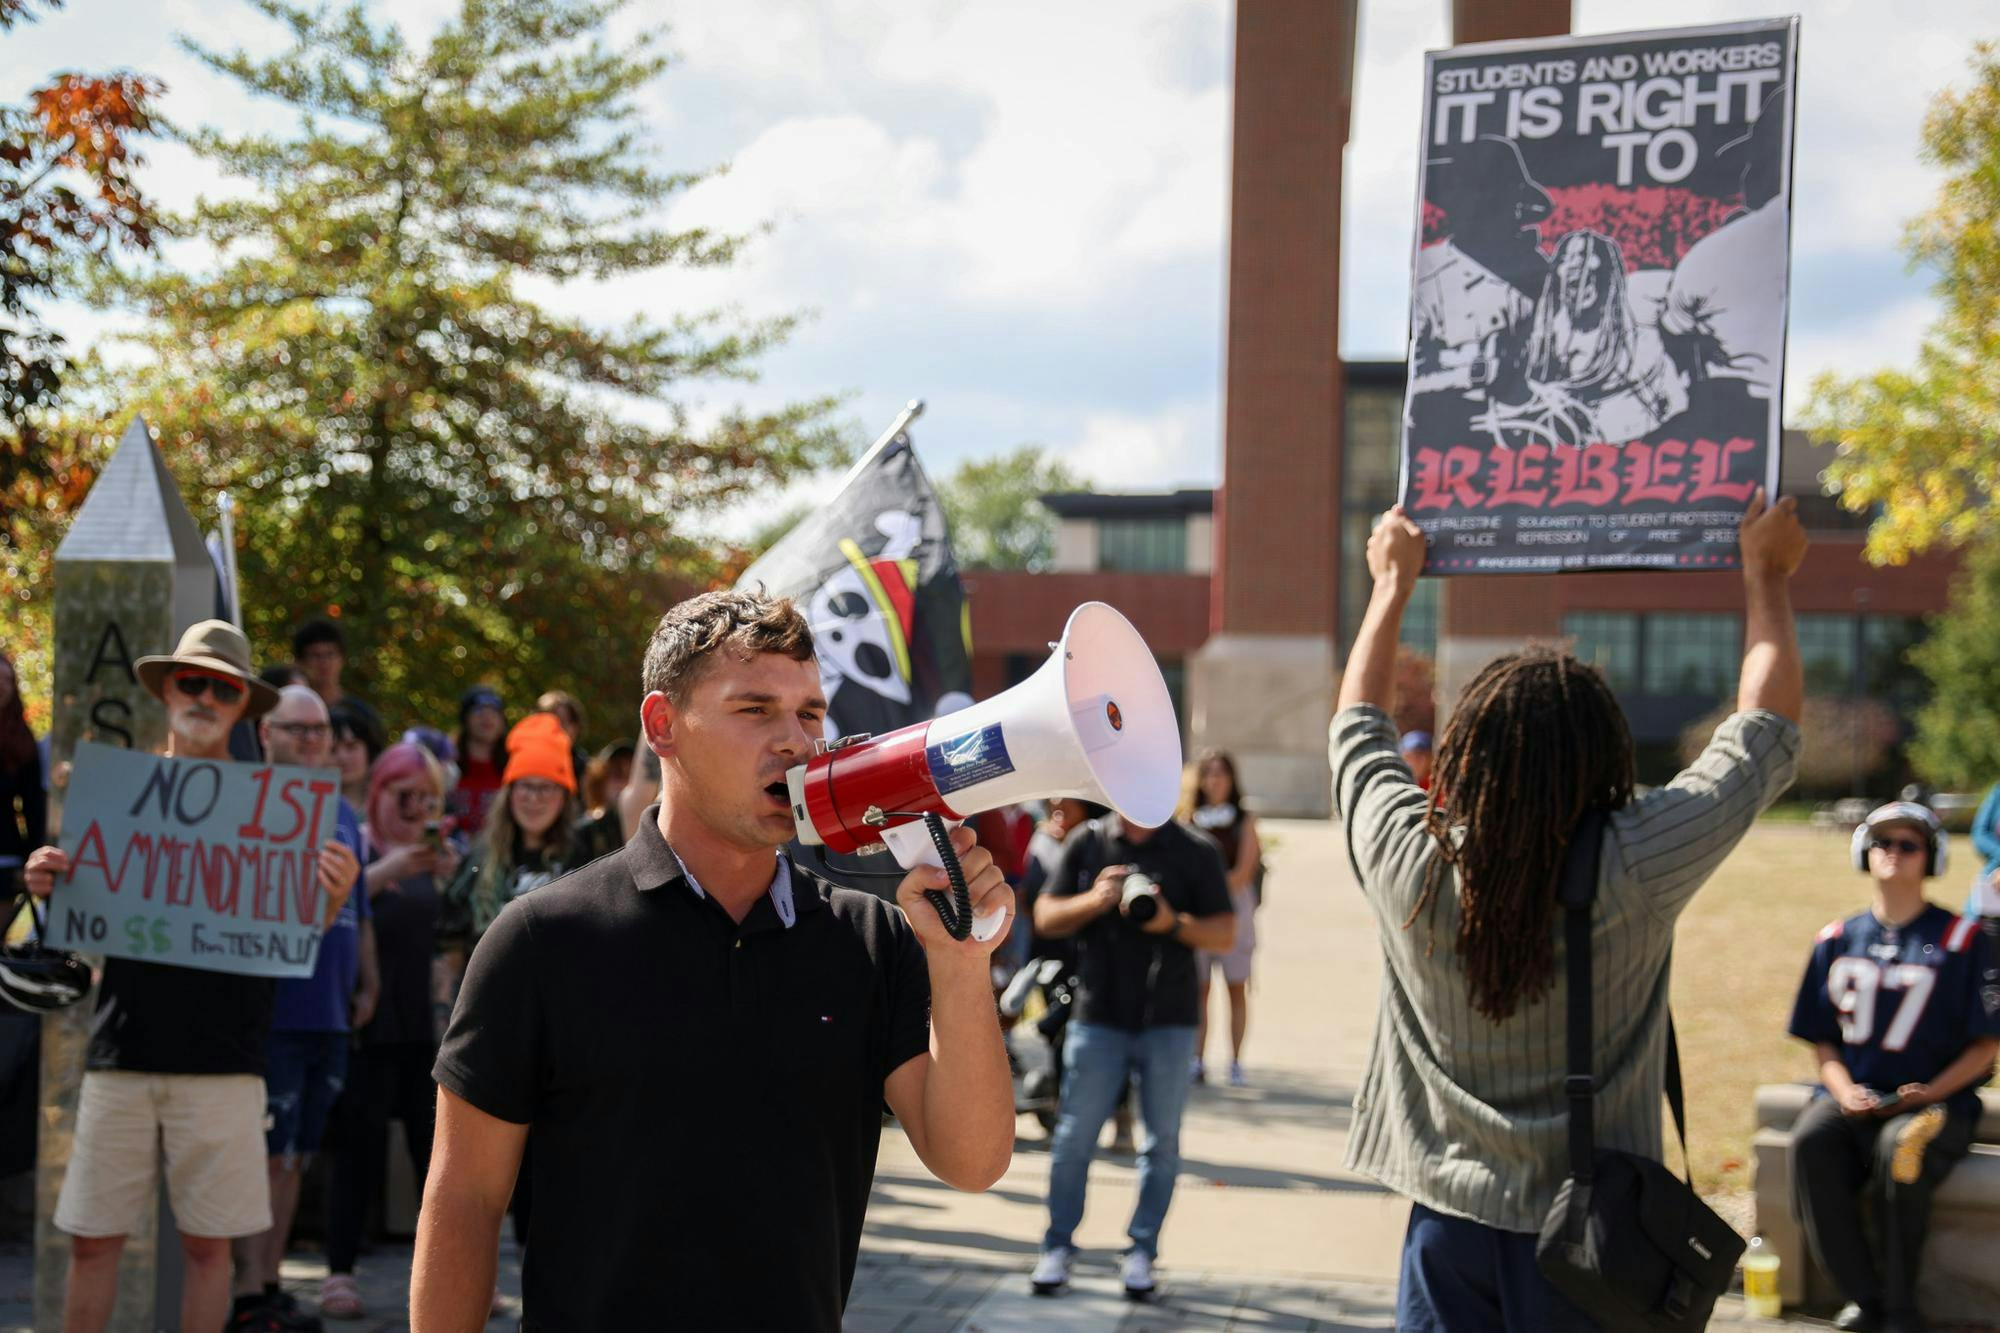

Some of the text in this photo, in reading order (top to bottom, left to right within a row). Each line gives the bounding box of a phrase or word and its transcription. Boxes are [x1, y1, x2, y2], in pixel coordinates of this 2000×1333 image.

[1436, 41, 1782, 93] STUDENTS AND WORKERS
[1434, 69, 1780, 145] IT IS RIGHT
[1601, 128, 1699, 186] TO
[1413, 436, 1756, 512] REBEL
[1440, 515, 1501, 531] PALESTINE
[1516, 514, 1587, 529] SOLIDARITY
[1588, 513, 1607, 528] TO
[1607, 512, 1668, 528] STUDENT
[1669, 510, 1745, 526] PROTESTOR
[1453, 532, 1496, 546] POLICE
[1515, 530, 1590, 545] REPRESSION
[1608, 529, 1630, 543] OF
[1648, 528, 1681, 543] FREE
[1702, 527, 1738, 543] SPEE
[130, 761, 335, 851] NO 1ST
[124, 914, 172, 955] $$
[1828, 956, 1938, 1051] 97
